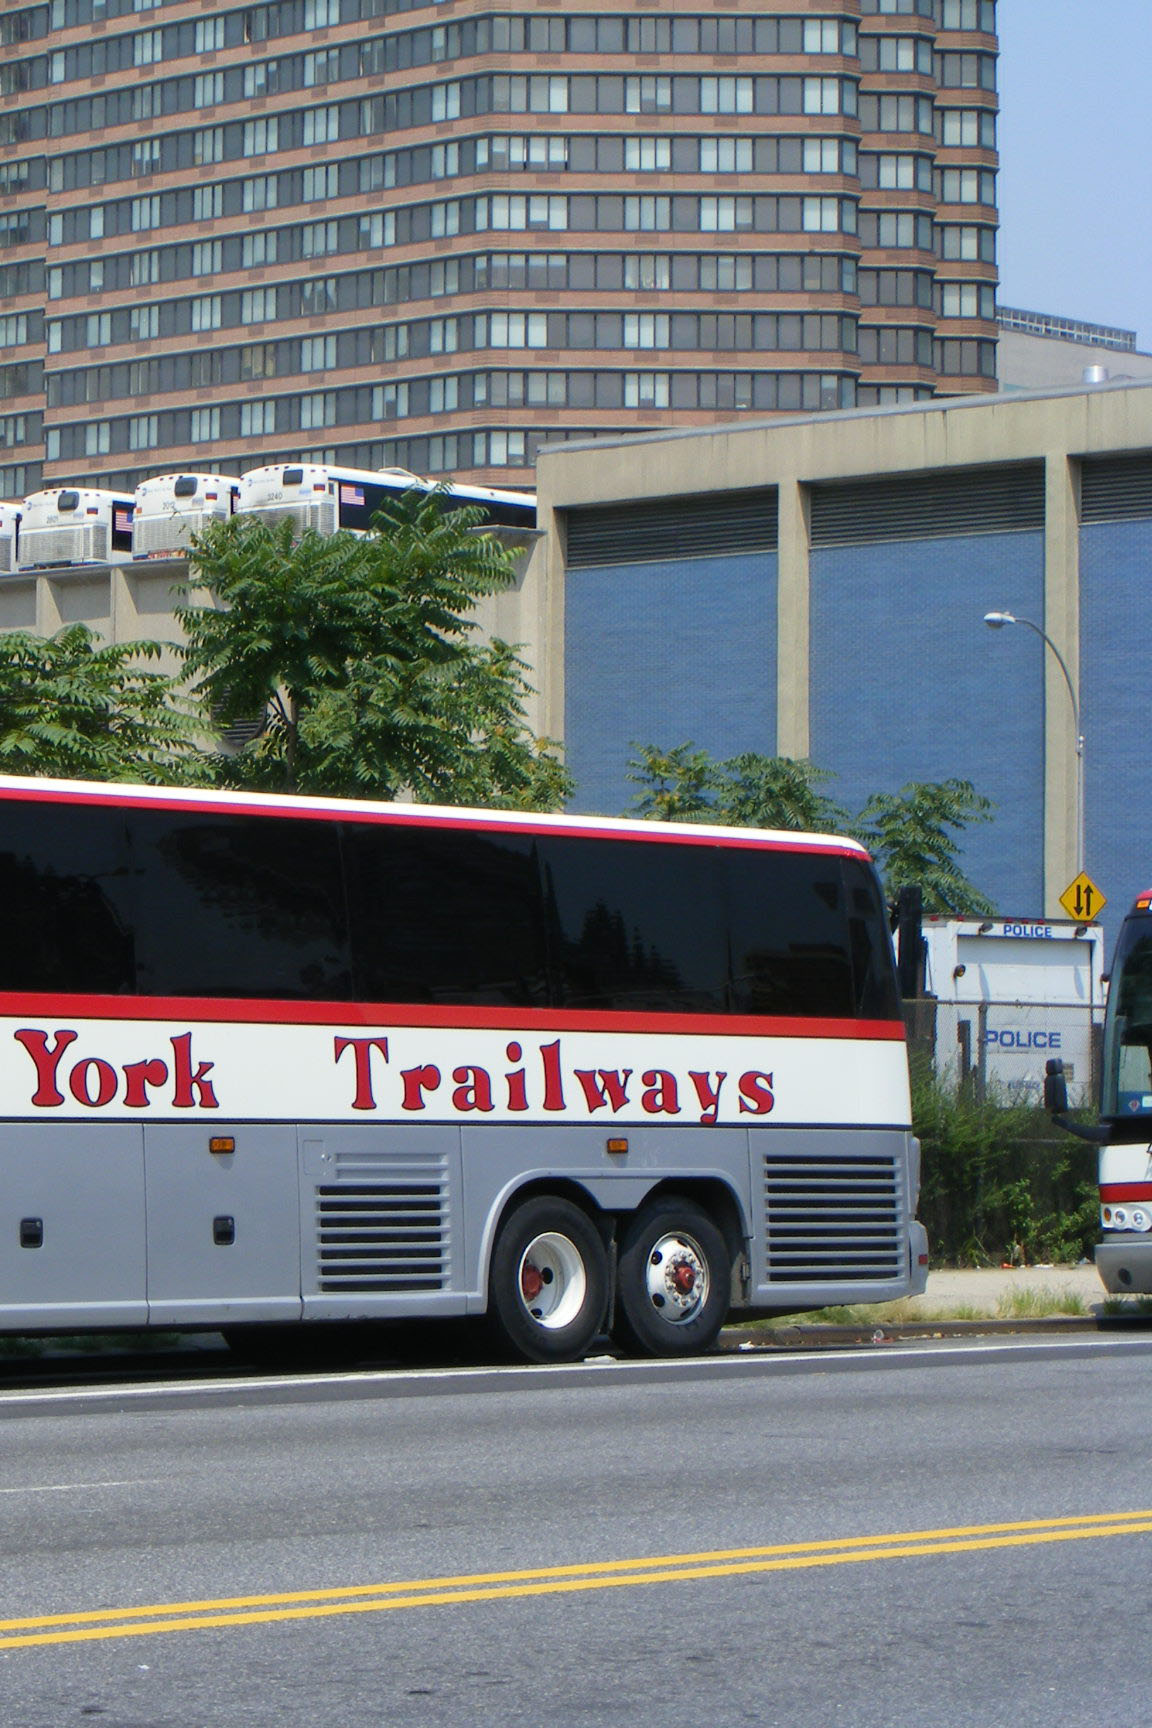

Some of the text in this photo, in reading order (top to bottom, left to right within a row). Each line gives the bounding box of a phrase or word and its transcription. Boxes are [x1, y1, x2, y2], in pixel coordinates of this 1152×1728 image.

[1003, 924, 1053, 938] POLICE
[985, 1030, 1062, 1049] POLICE
[14, 1029, 221, 1108] York
[333, 1035, 776, 1125] Trailways
